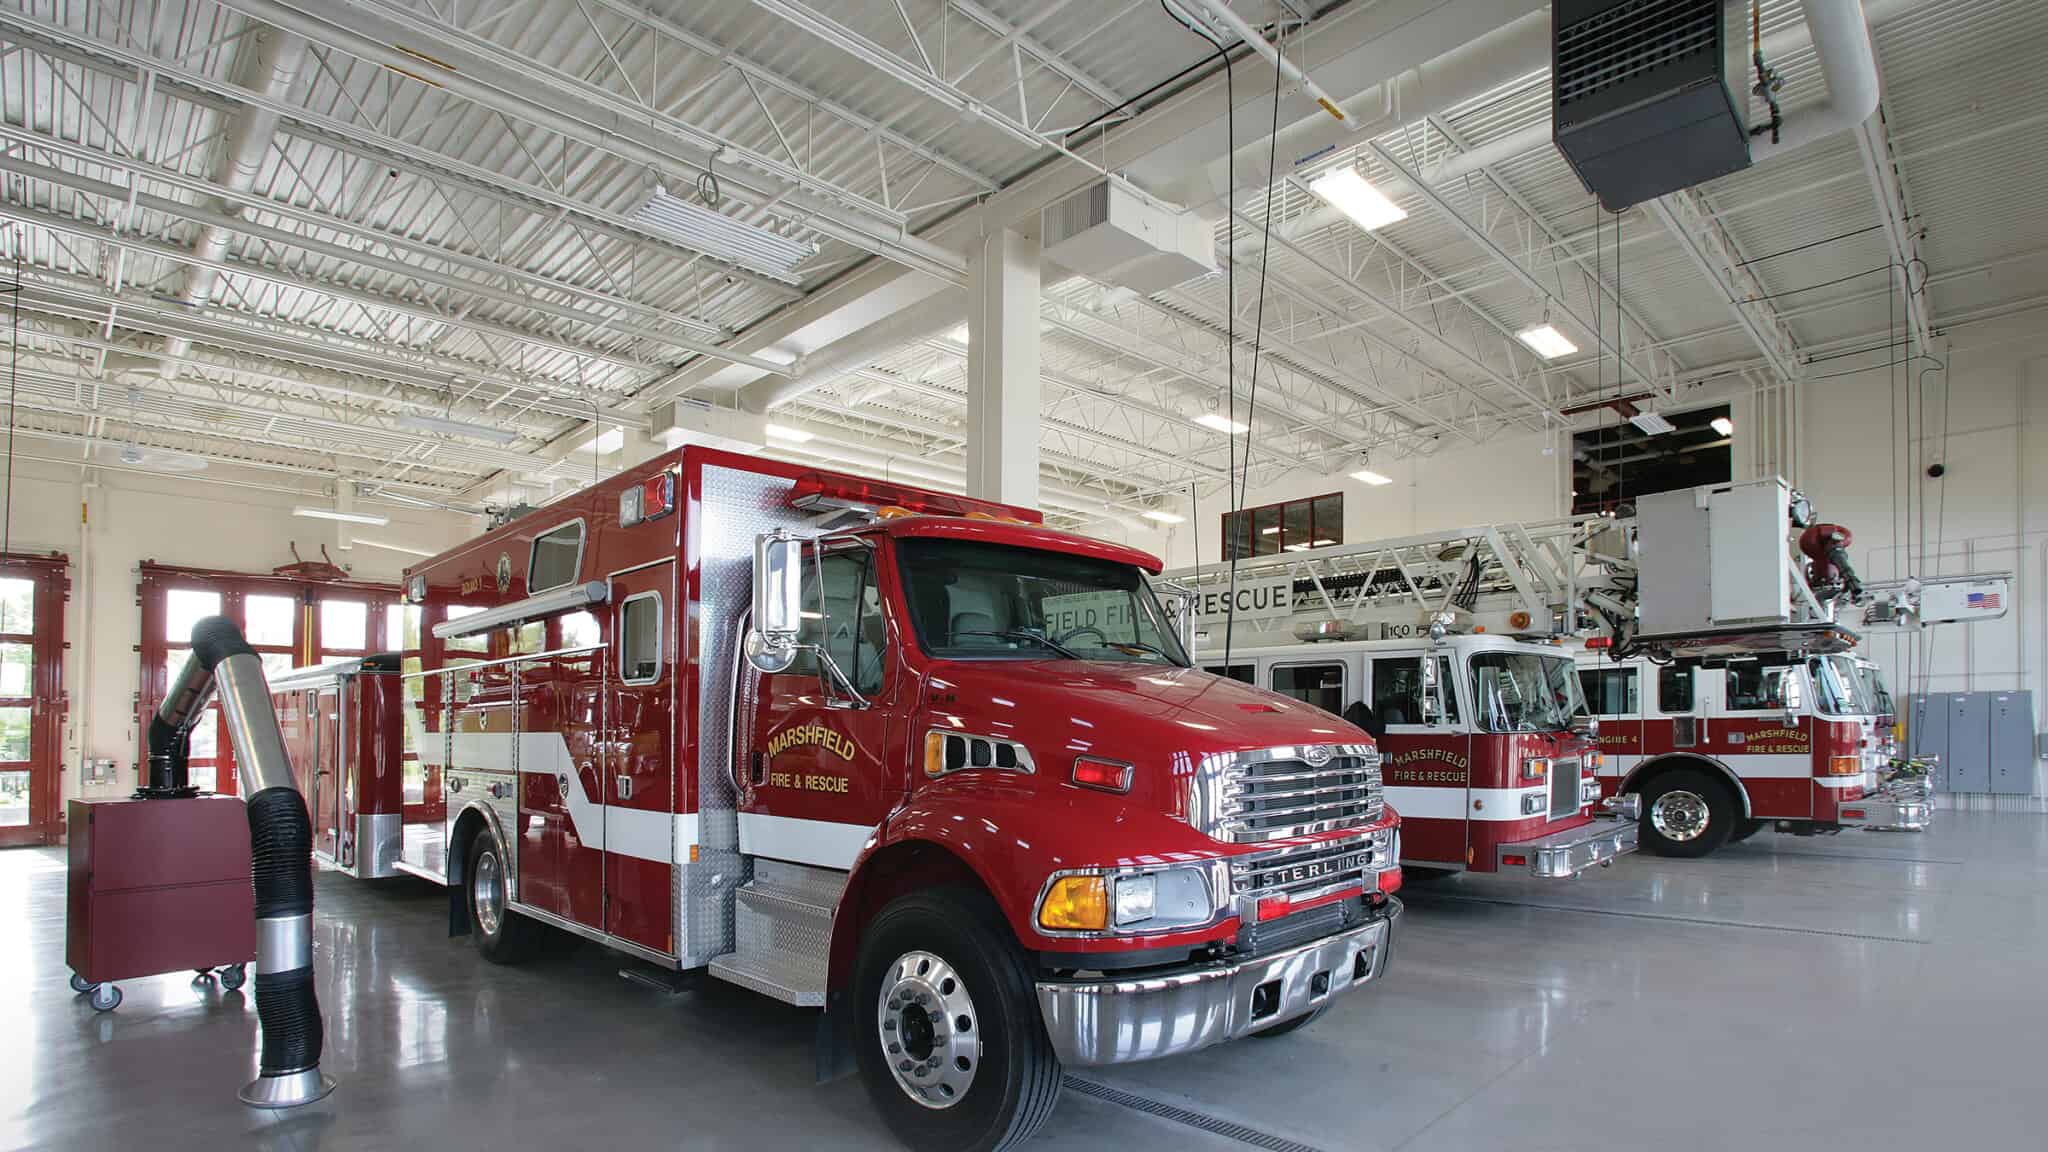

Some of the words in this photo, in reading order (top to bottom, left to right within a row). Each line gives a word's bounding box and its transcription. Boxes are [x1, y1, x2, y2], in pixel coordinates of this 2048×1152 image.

[1164, 600, 1177, 618] &
[1188, 585, 1287, 616] RESCUE
[1389, 624, 1410, 637] 100
[767, 725, 855, 761] MARSHFIELD
[1599, 735, 1628, 744] NGINE
[1745, 729, 1808, 742] MARSHFIELD
[1746, 744, 1766, 753] FIRE
[1776, 744, 1809, 753] RESCUE
[1394, 748, 1467, 768] MARSHFIELD
[770, 773, 791, 788] FIRE
[794, 774, 801, 789] &
[805, 775, 849, 793] RESCUE
[1393, 770, 1416, 781] FIRE
[1418, 770, 1424, 781] &
[1427, 771, 1467, 782] RESCUE
[1263, 855, 1368, 886] STERLING
